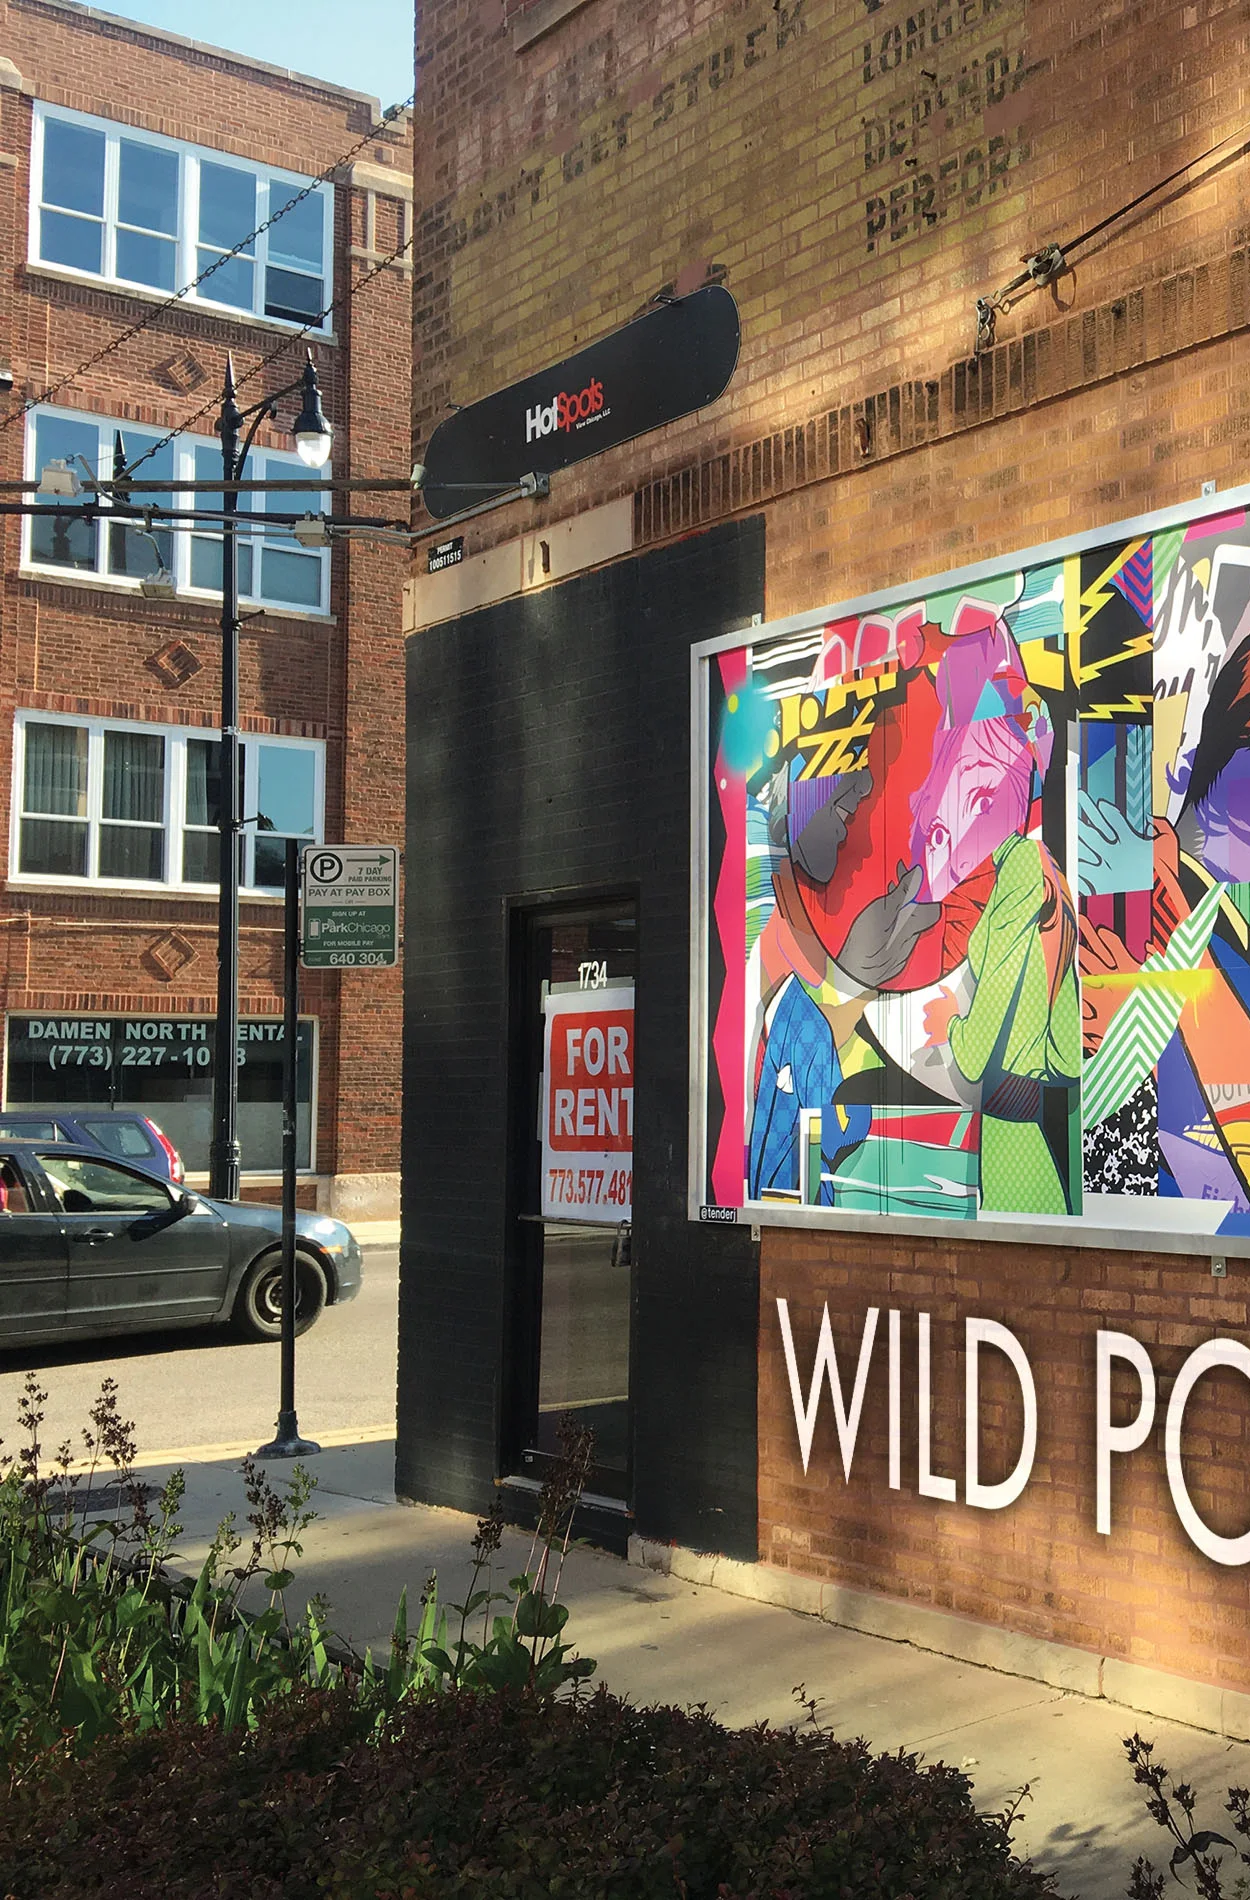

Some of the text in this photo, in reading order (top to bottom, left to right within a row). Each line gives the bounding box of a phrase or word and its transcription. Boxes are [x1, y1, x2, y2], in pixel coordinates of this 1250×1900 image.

[526, 377, 604, 443] HotSpots
[357, 867, 383, 875] 7 DAY
[308, 888, 390, 897] PAY AT PAY BOX
[321, 921, 391, 935] ParkChicago
[329, 953, 355, 965] 640
[578, 960, 608, 989] 1734
[28, 1021, 111, 1040] DAMEN
[125, 1022, 206, 1041] NORTH
[49, 1045, 113, 1070] (773)
[566, 1026, 631, 1077] FOR
[554, 1087, 634, 1136] RENT
[701, 1207, 736, 1223] @tenderj
